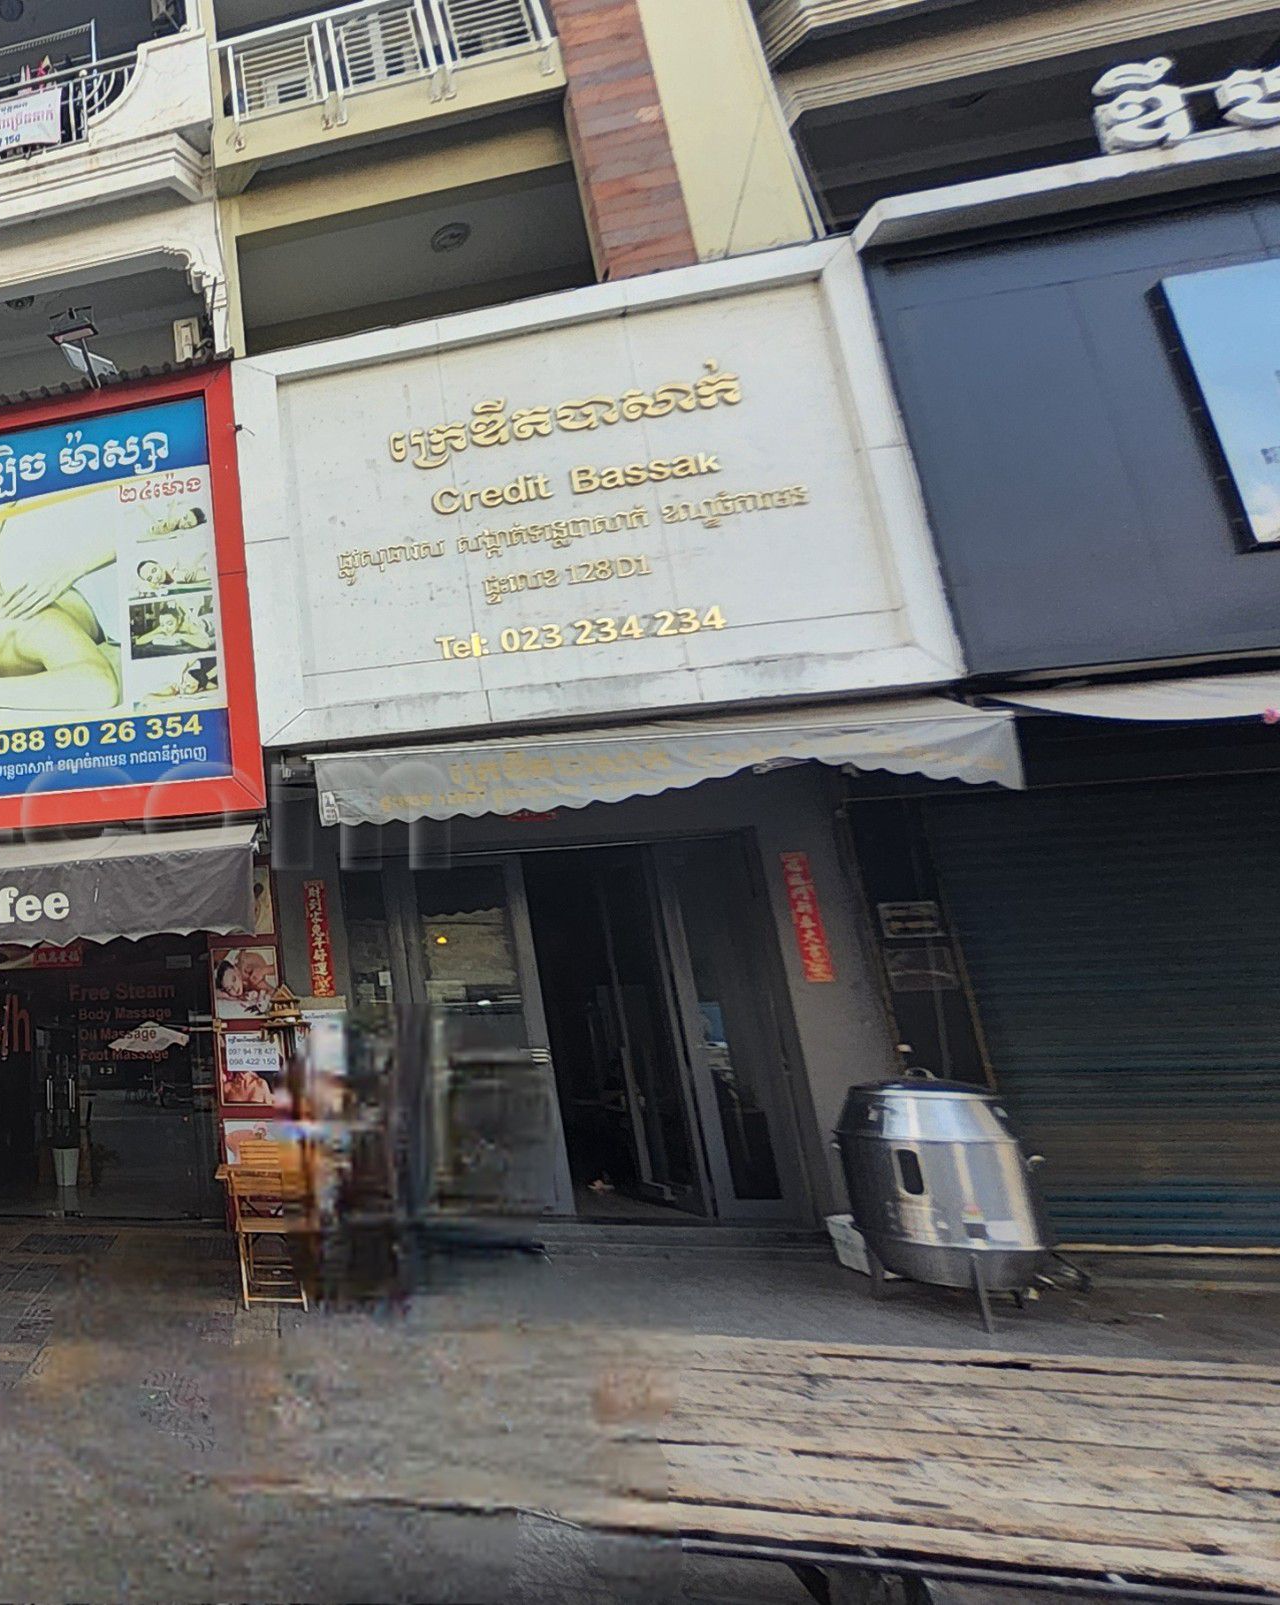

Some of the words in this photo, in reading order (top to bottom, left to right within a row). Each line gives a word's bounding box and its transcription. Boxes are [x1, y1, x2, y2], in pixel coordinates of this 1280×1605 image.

[431, 473, 554, 515] Credit
[570, 450, 724, 495] Bassak
[435, 632, 488, 662] Tel:
[500, 620, 564, 655] 023
[573, 613, 645, 648] 234
[655, 603, 727, 638] 234
[55, 725, 91, 749] 90
[100, 720, 137, 744] 26
[146, 714, 203, 739] 354
[70, 984, 110, 1001] Free
[115, 982, 176, 1000] Steam
[78, 1008, 111, 1022] Body
[115, 1006, 172, 1021] Massage
[78, 1027, 98, 1041] Oil
[100, 1026, 158, 1042] Massage
[79, 1049, 110, 1062] Foot
[112, 1048, 170, 1063] Massage
